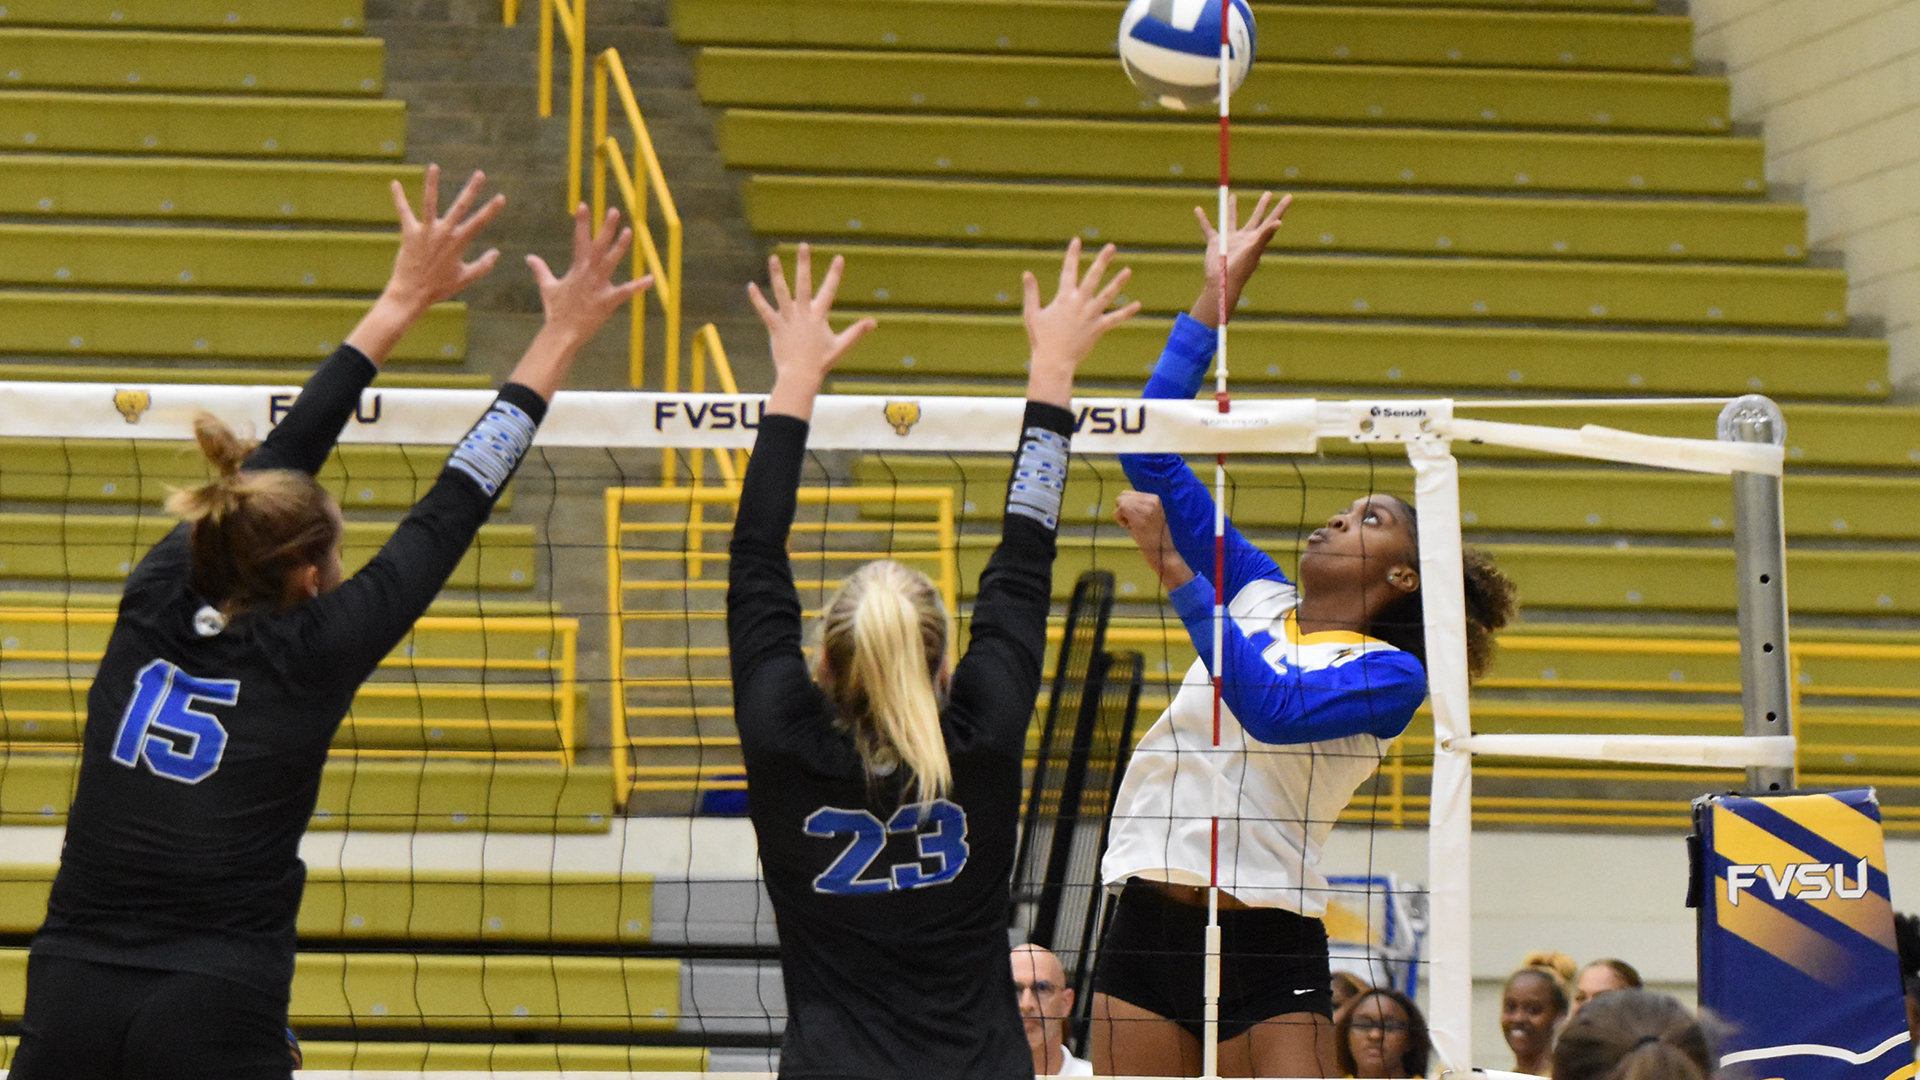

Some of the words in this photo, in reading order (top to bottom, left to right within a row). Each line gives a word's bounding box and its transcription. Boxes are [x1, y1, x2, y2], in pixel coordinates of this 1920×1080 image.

[270, 395, 381, 425] FU
[655, 401, 765, 432] FVSU
[1074, 405, 1146, 434] VSU
[111, 658, 241, 785] 15
[803, 799, 970, 895] 23
[1727, 857, 1868, 906] FVSU
